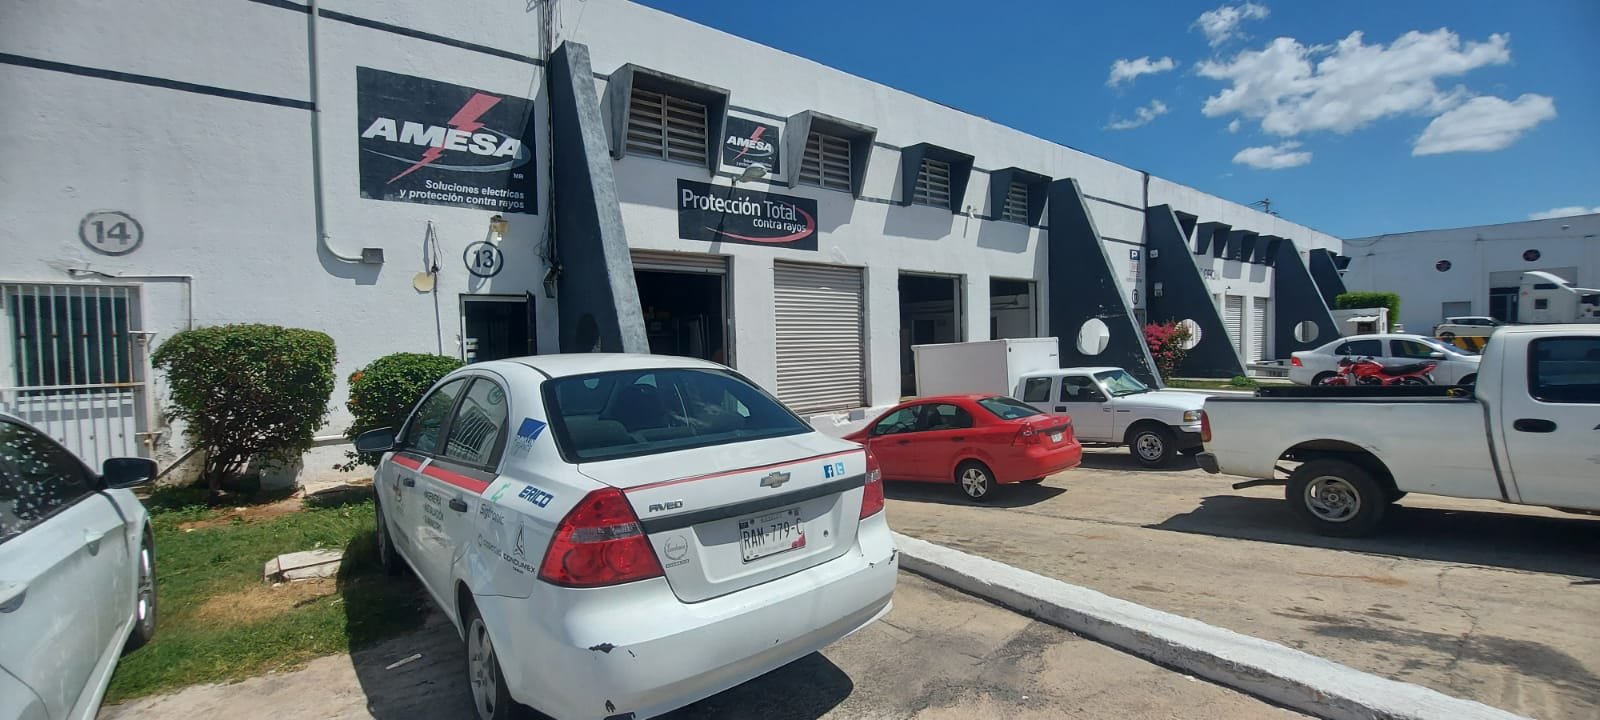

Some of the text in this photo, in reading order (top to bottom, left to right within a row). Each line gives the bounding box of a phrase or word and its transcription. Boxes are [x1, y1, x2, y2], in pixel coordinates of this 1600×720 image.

[361, 117, 522, 159] AMESA
[726, 135, 773, 153] AMESA
[399, 189, 525, 209] y protección contra rayos
[425, 180, 525, 200] Soluciones electricas
[682, 189, 797, 222] Protección Total
[91, 220, 132, 245] 14
[753, 218, 807, 234] contra rayos
[472, 250, 494, 268] 13
[518, 485, 554, 508] ERICO
[649, 500, 684, 512] AVEO
[743, 517, 803, 550] RAM-779-C
